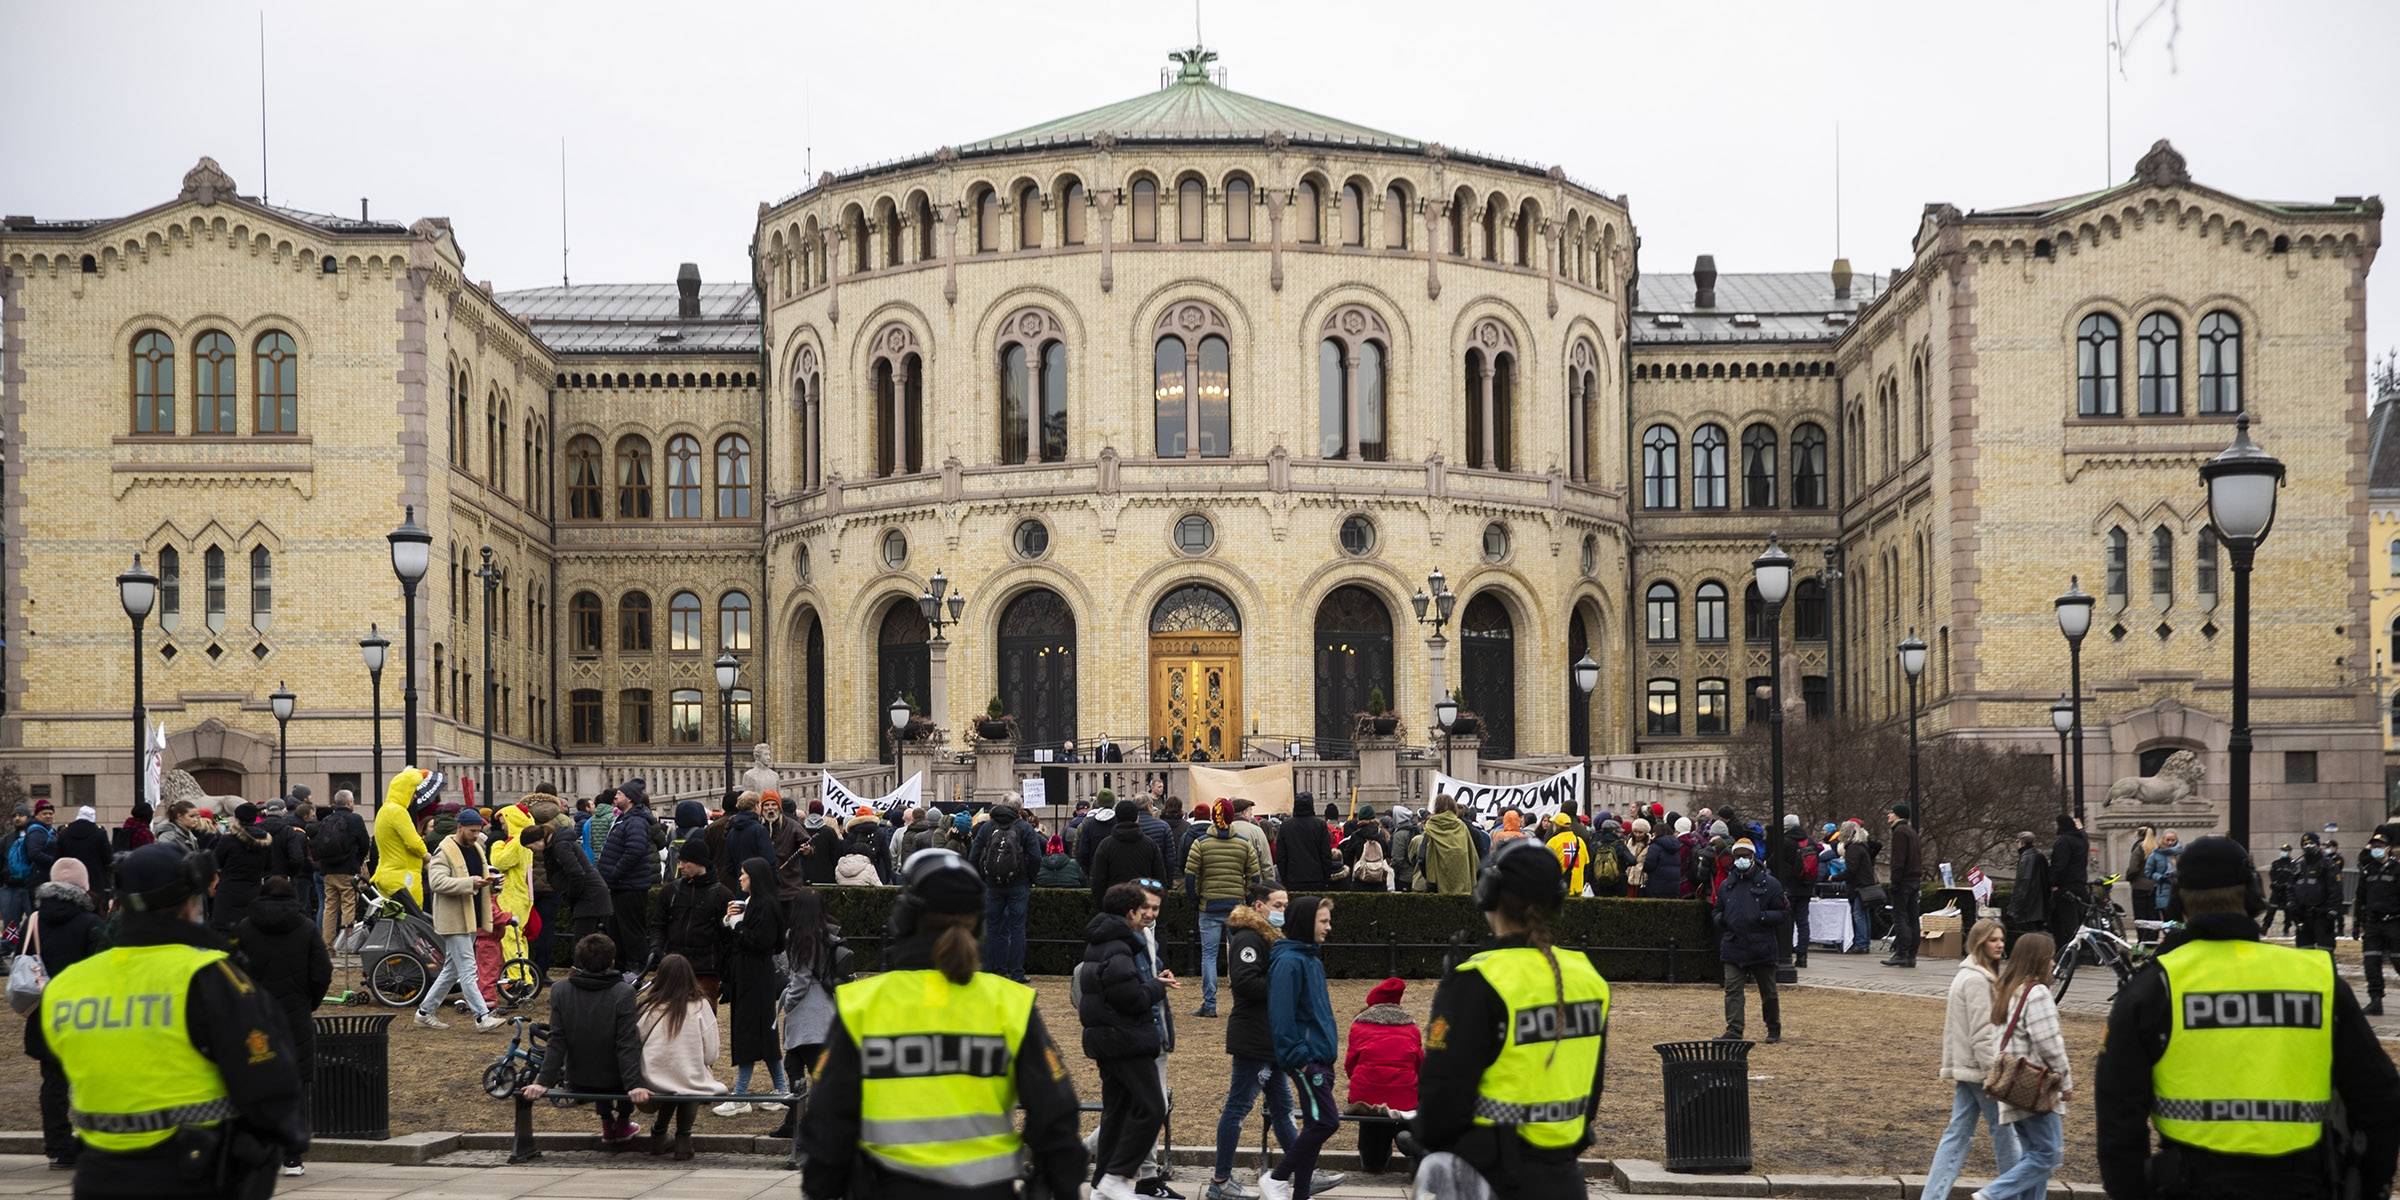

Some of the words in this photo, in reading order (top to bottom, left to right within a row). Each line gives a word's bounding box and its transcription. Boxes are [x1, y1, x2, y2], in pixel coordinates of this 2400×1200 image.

[54, 994, 172, 1032] POLITI
[2185, 992, 2322, 1026] POLITI
[2211, 1100, 2293, 1120] POLITI
